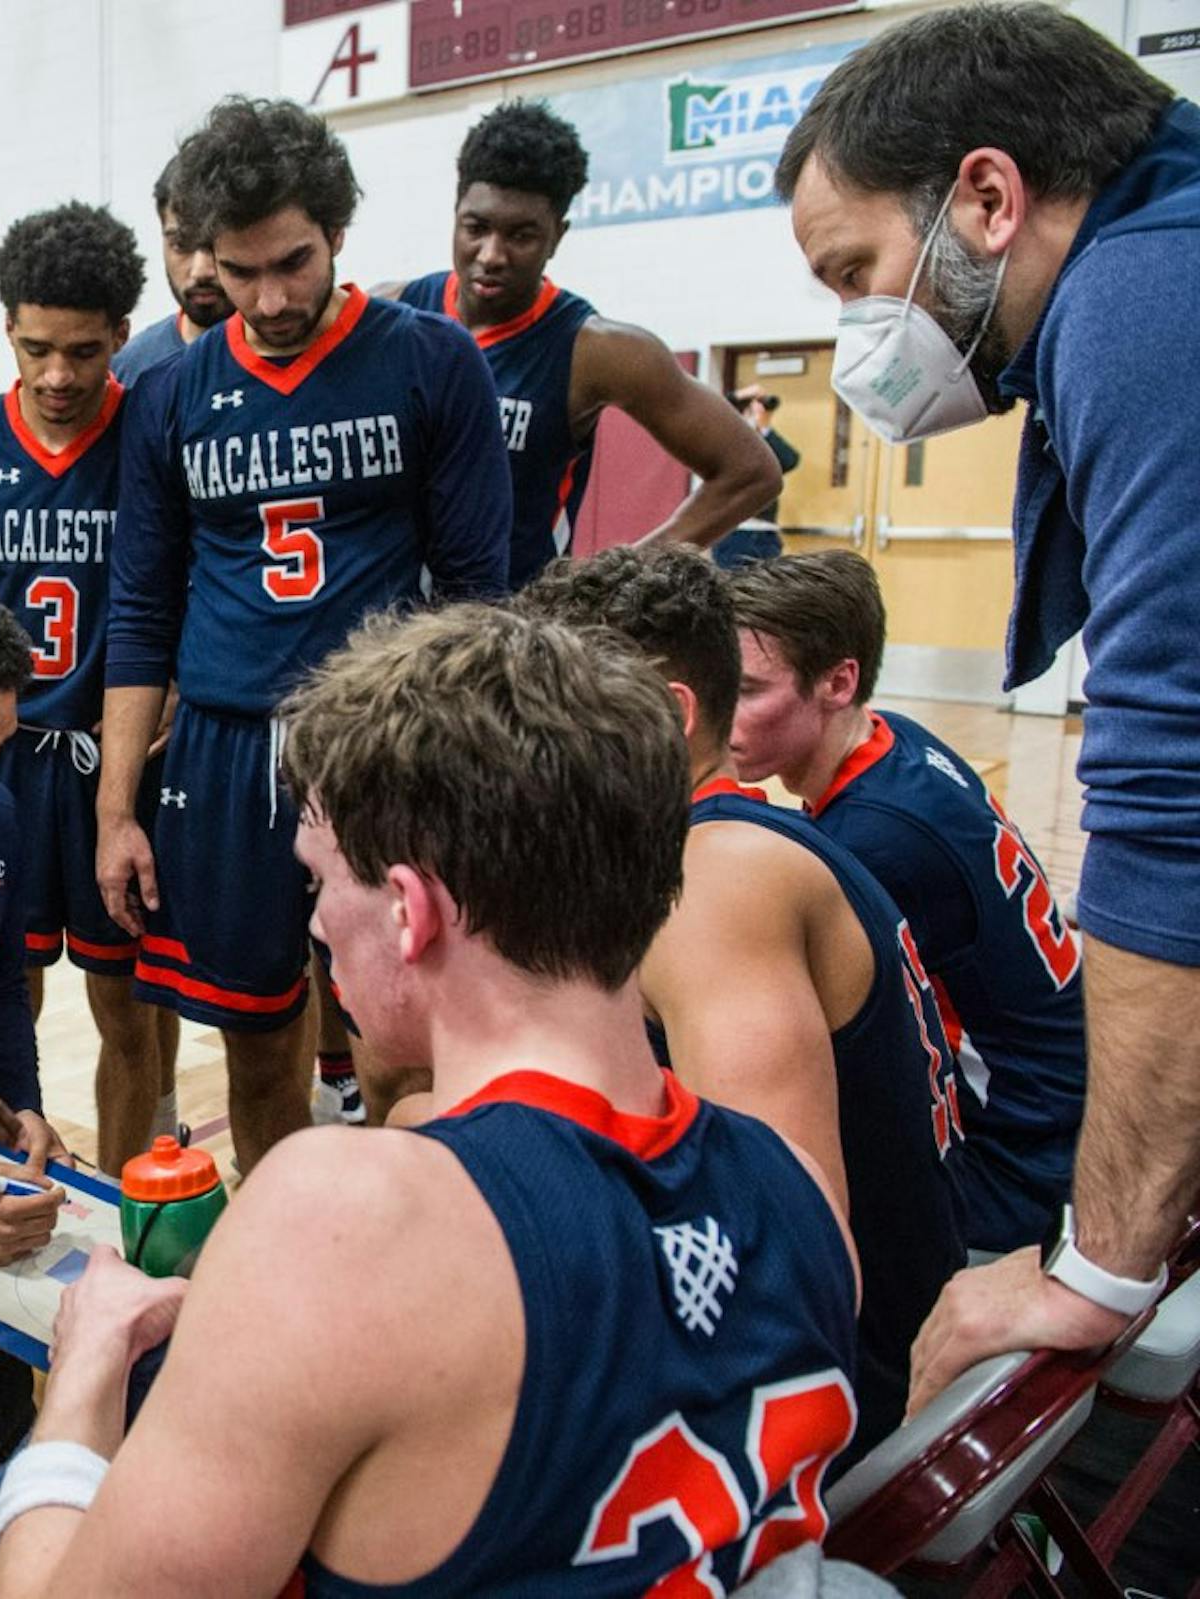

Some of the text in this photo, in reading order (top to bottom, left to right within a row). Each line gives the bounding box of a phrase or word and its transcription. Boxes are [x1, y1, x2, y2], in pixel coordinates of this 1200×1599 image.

[568, 158, 776, 221] HAMPIO
[182, 415, 404, 500] MACALESTER
[259, 496, 325, 604] 5
[25, 576, 80, 680] 3
[987, 792, 1084, 993] 2
